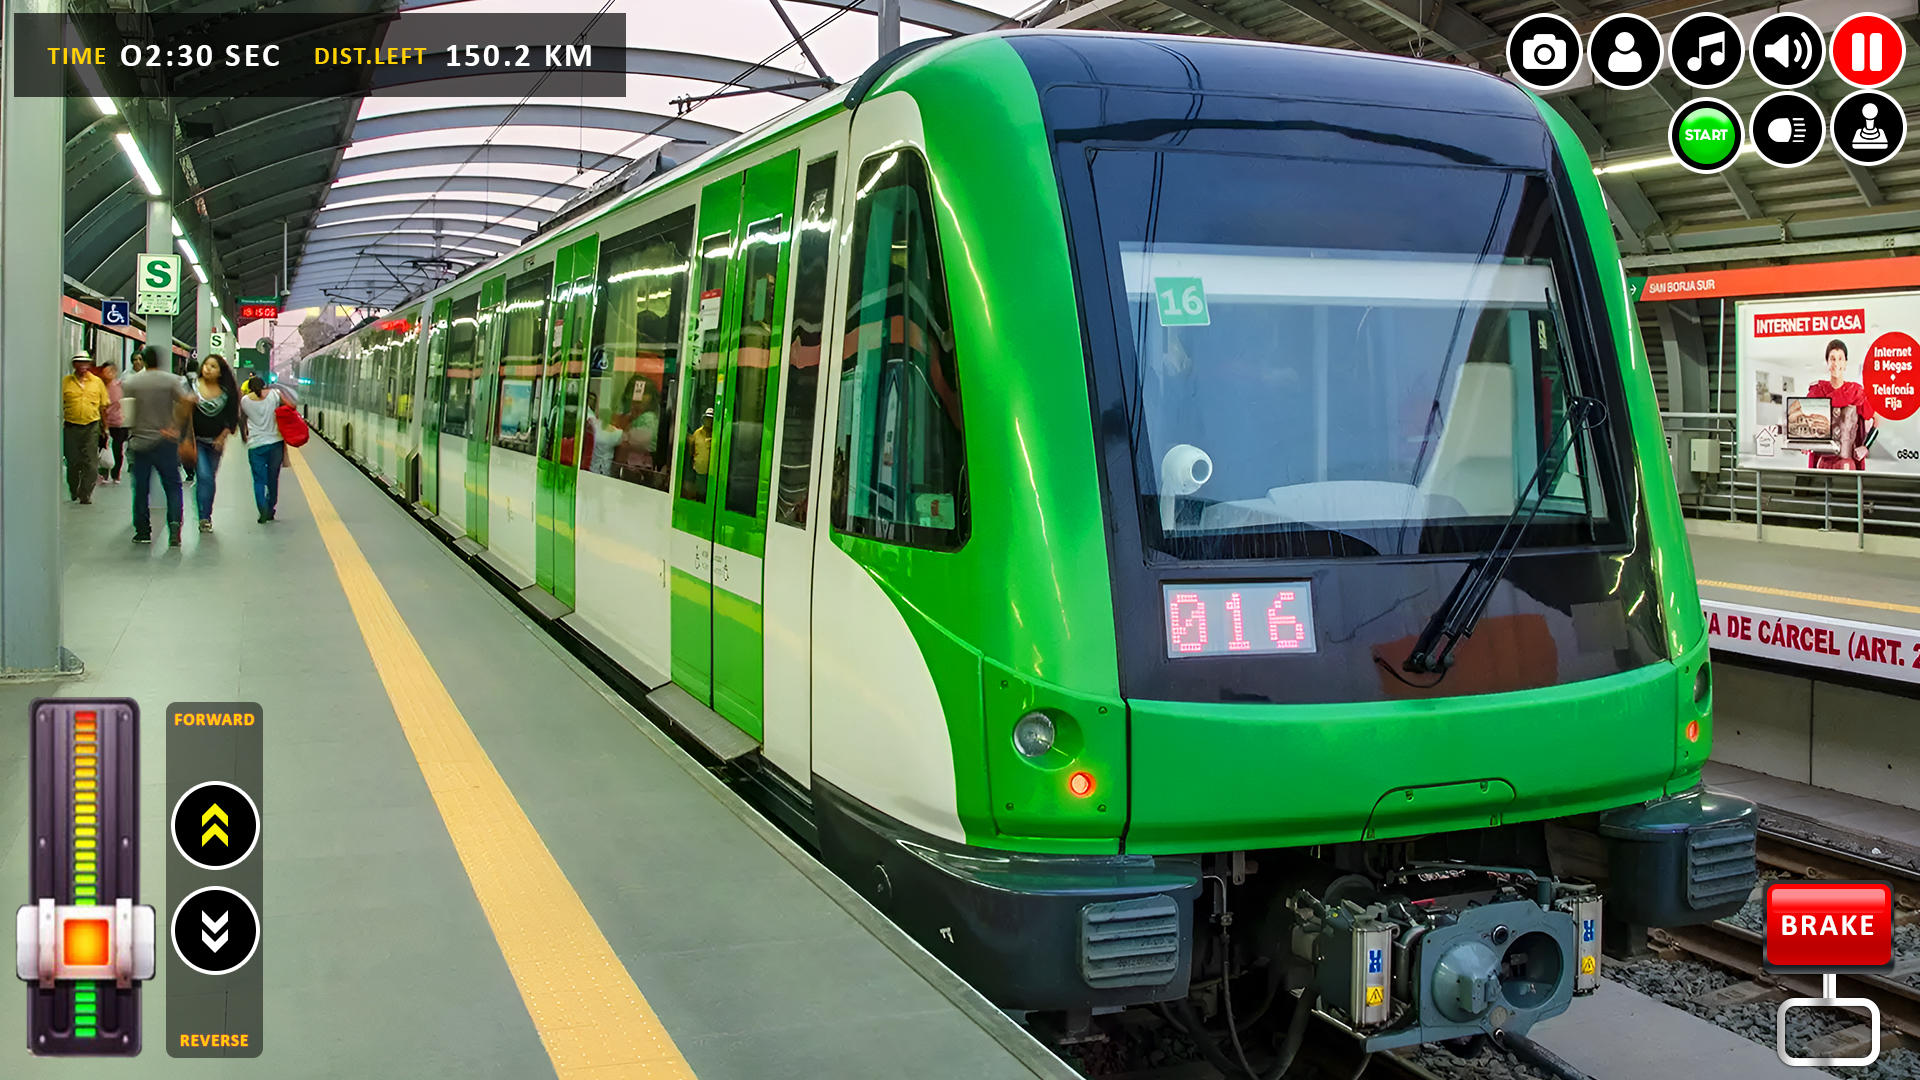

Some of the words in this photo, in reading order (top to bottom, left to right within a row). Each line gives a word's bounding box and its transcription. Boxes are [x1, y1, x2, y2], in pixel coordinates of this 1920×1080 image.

[145, 260, 172, 288] S
[1667, 281, 1696, 293] BORJA
[1696, 279, 1716, 291] SUR
[1160, 285, 1204, 315] 16
[1756, 317, 1811, 334] INTERNET
[1812, 316, 1829, 331] EN
[1830, 314, 1862, 330] CASA
[211, 335, 222, 346] S
[1874, 346, 1912, 358] Internet
[1882, 360, 1913, 374] Megas
[1170, 592, 1305, 652] 016
[1727, 615, 1752, 641] DE
[1758, 617, 1841, 656] CÁRCEL
